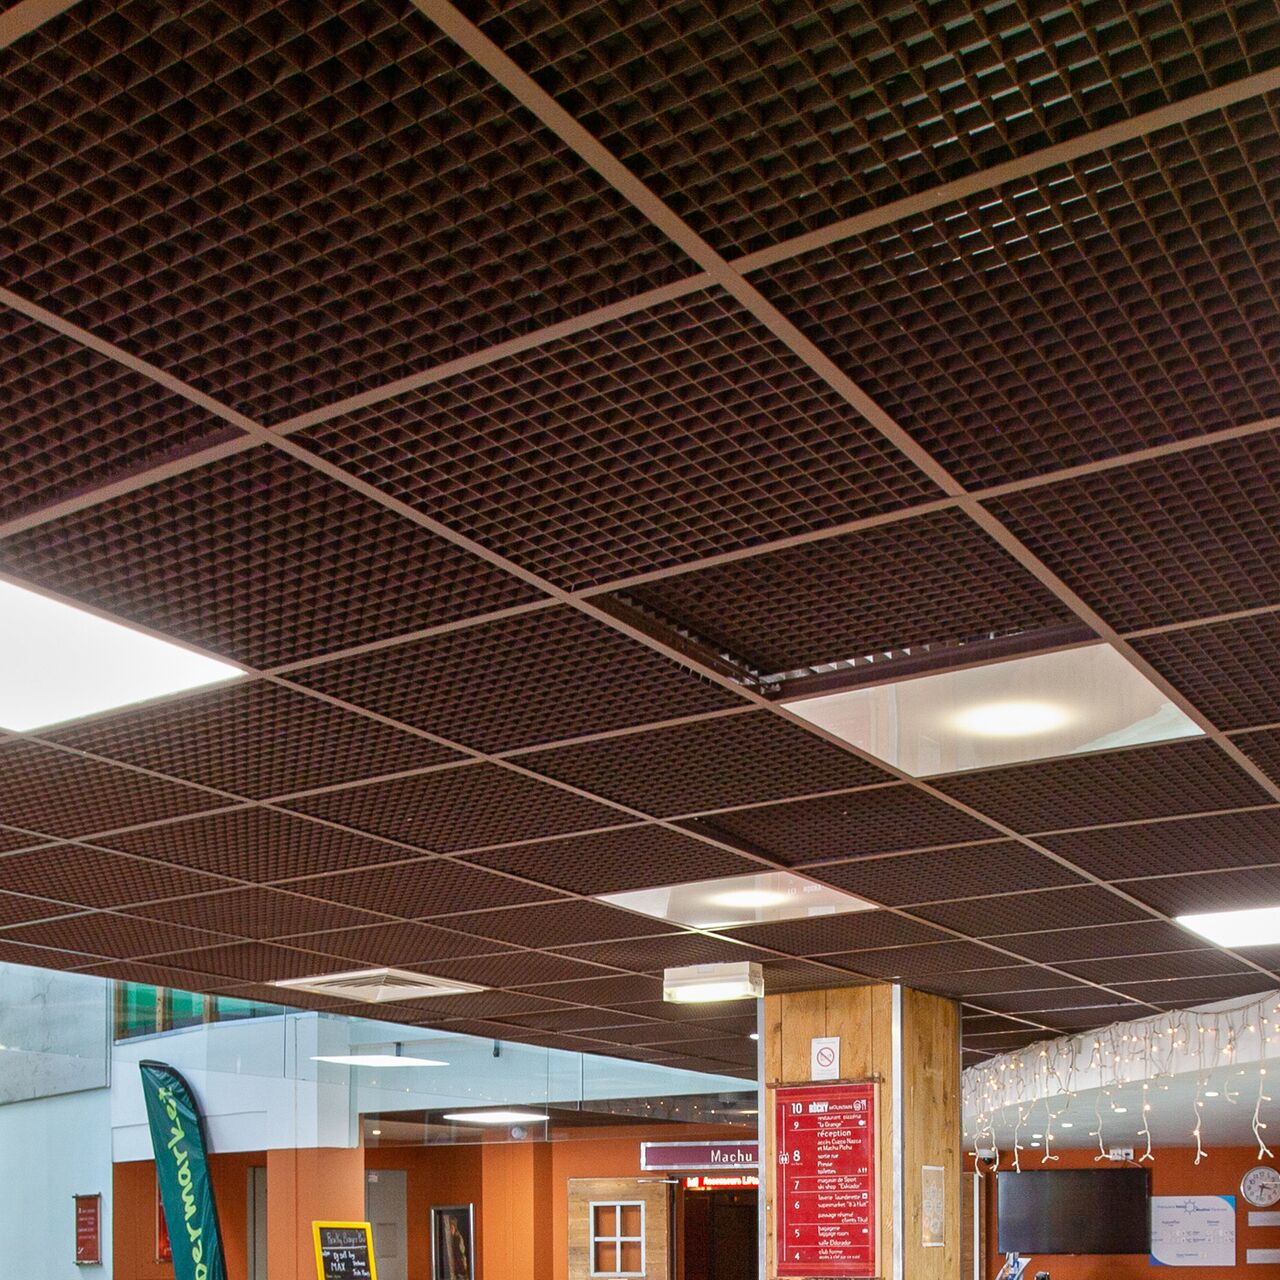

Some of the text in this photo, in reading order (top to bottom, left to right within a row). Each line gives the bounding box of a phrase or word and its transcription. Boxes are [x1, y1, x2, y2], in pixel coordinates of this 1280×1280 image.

[792, 1103, 803, 1114] 10
[794, 1121, 799, 1130] 9
[817, 1130, 851, 1138] réception
[711, 1150, 752, 1163] Machu
[793, 1150, 800, 1162] 8
[795, 1181, 799, 1190] 7
[794, 1201, 800, 1209] 6
[795, 1229, 800, 1238] 5
[794, 1252, 800, 1260] 4
